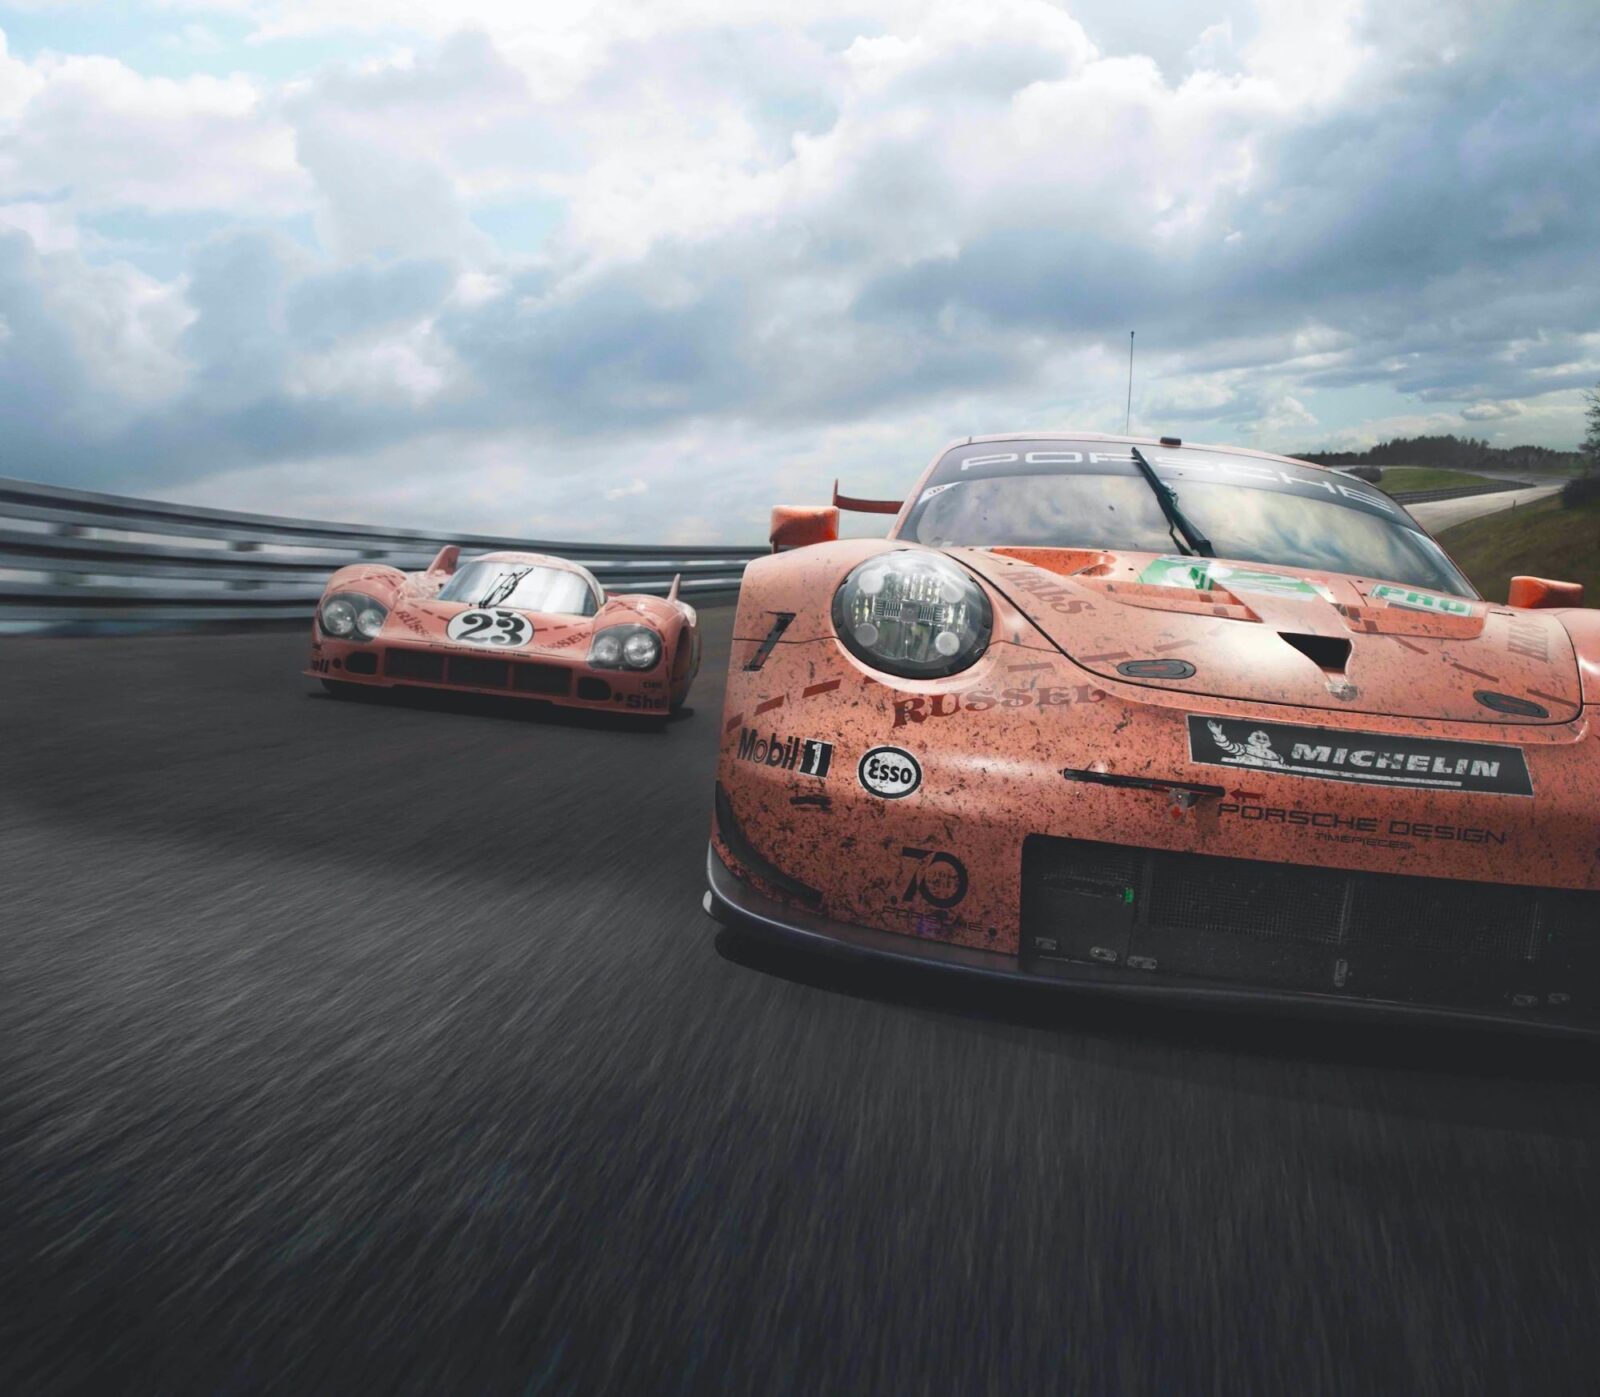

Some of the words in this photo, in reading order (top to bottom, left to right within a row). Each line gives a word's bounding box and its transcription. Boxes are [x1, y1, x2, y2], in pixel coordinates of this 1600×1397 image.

[961, 450, 1396, 515] PORSCHE
[456, 610, 526, 647] 23
[736, 727, 800, 771] Mobil
[1291, 742, 1501, 778] MICHELIN
[868, 758, 912, 785] Esso
[1217, 802, 1379, 833] PORSCHE
[1388, 819, 1508, 846] DESIGN
[1314, 831, 1415, 851] TIMEPIECES
